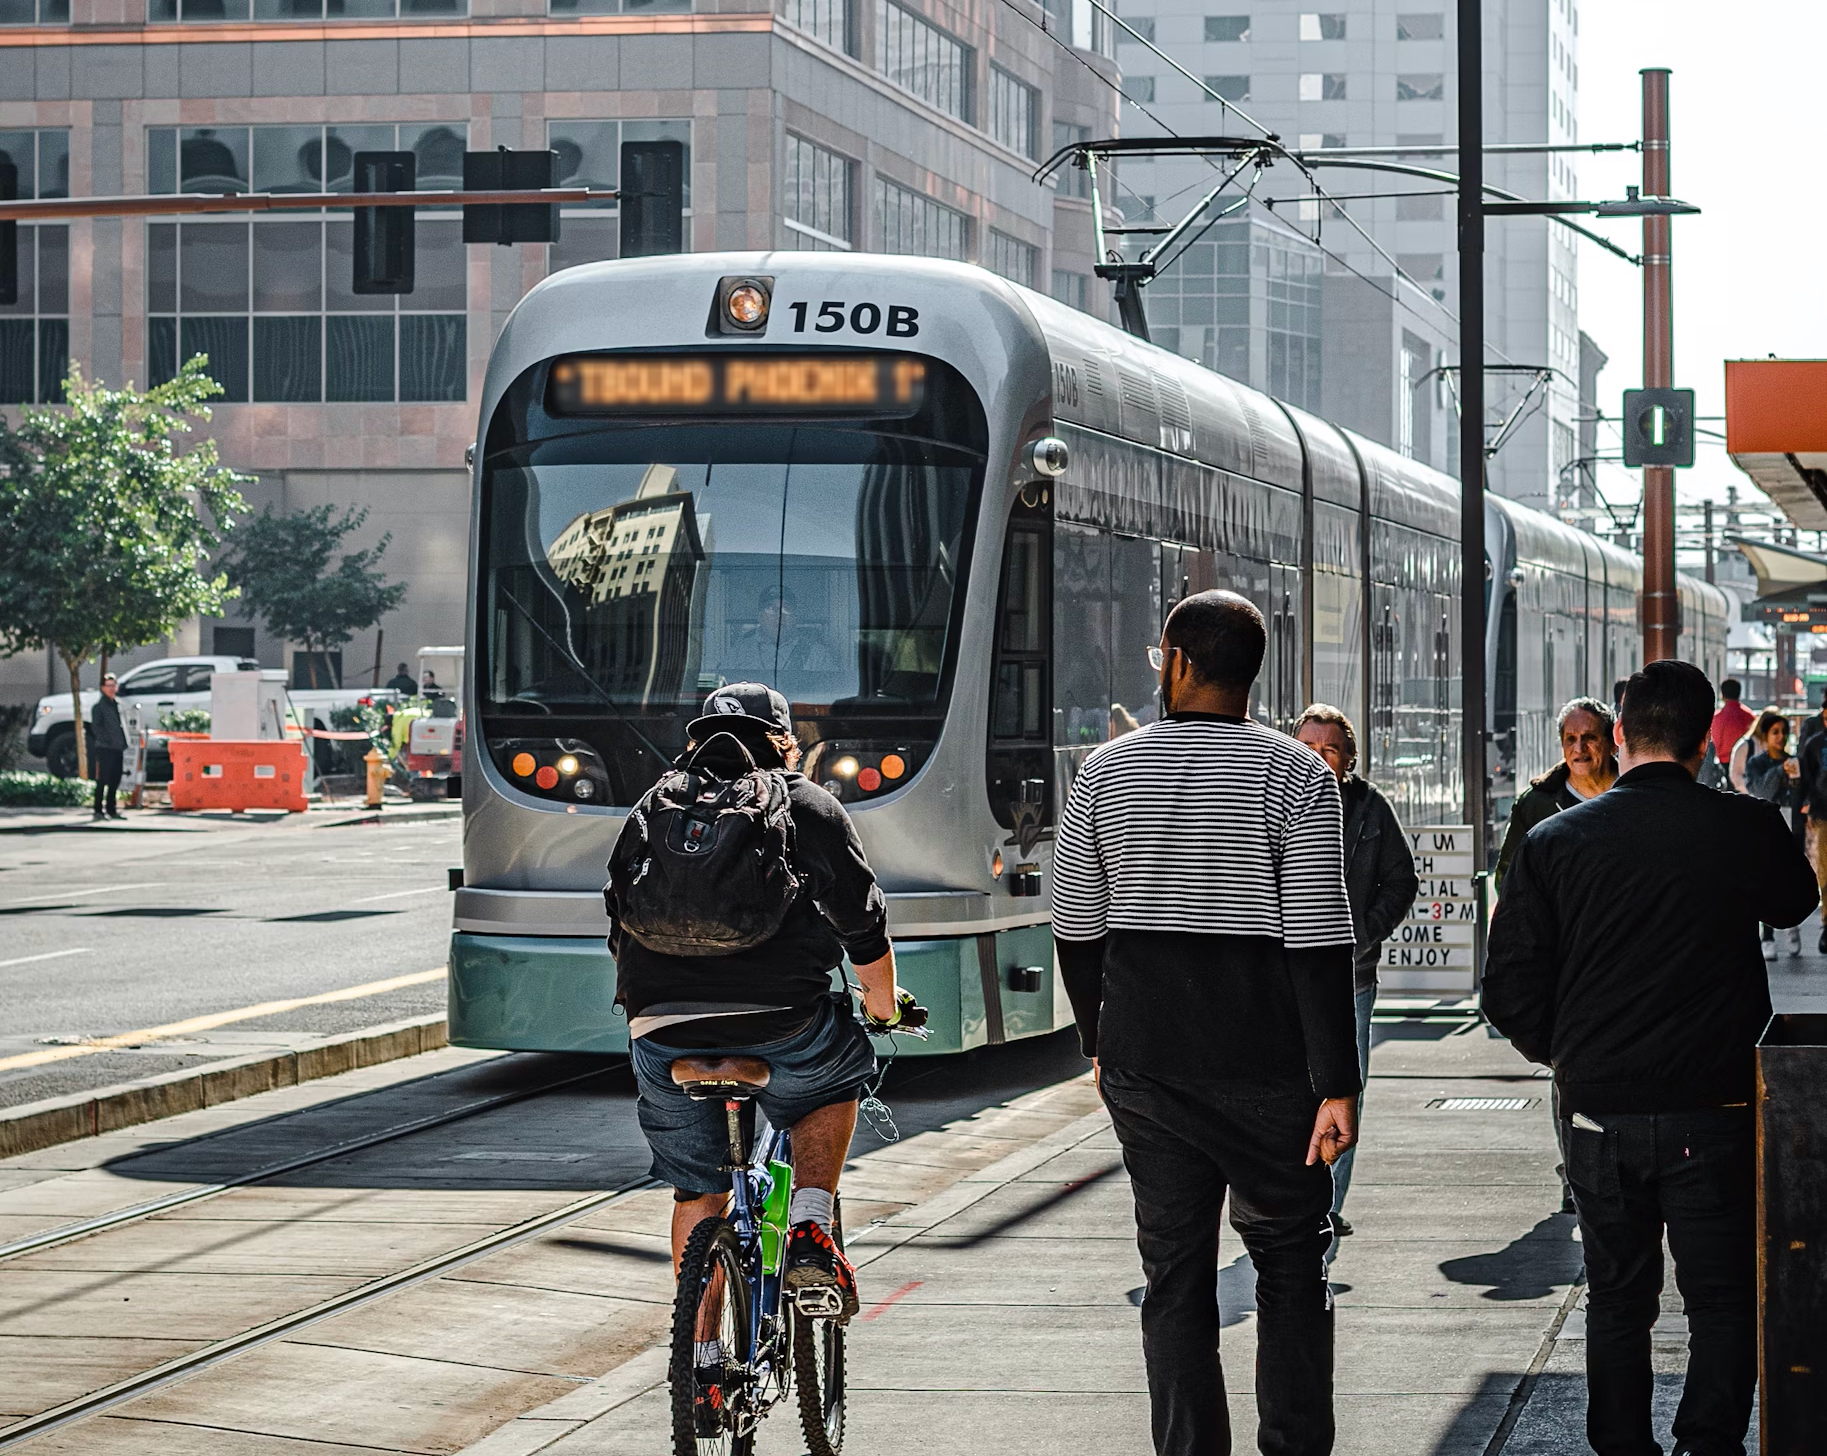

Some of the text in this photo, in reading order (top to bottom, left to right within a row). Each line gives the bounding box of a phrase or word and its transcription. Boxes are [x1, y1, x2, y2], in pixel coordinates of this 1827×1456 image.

[788, 301, 919, 338] 150B
[1055, 362, 1079, 408] 150B
[1433, 834, 1455, 851] UM
[1388, 948, 1450, 966] ENJOY
